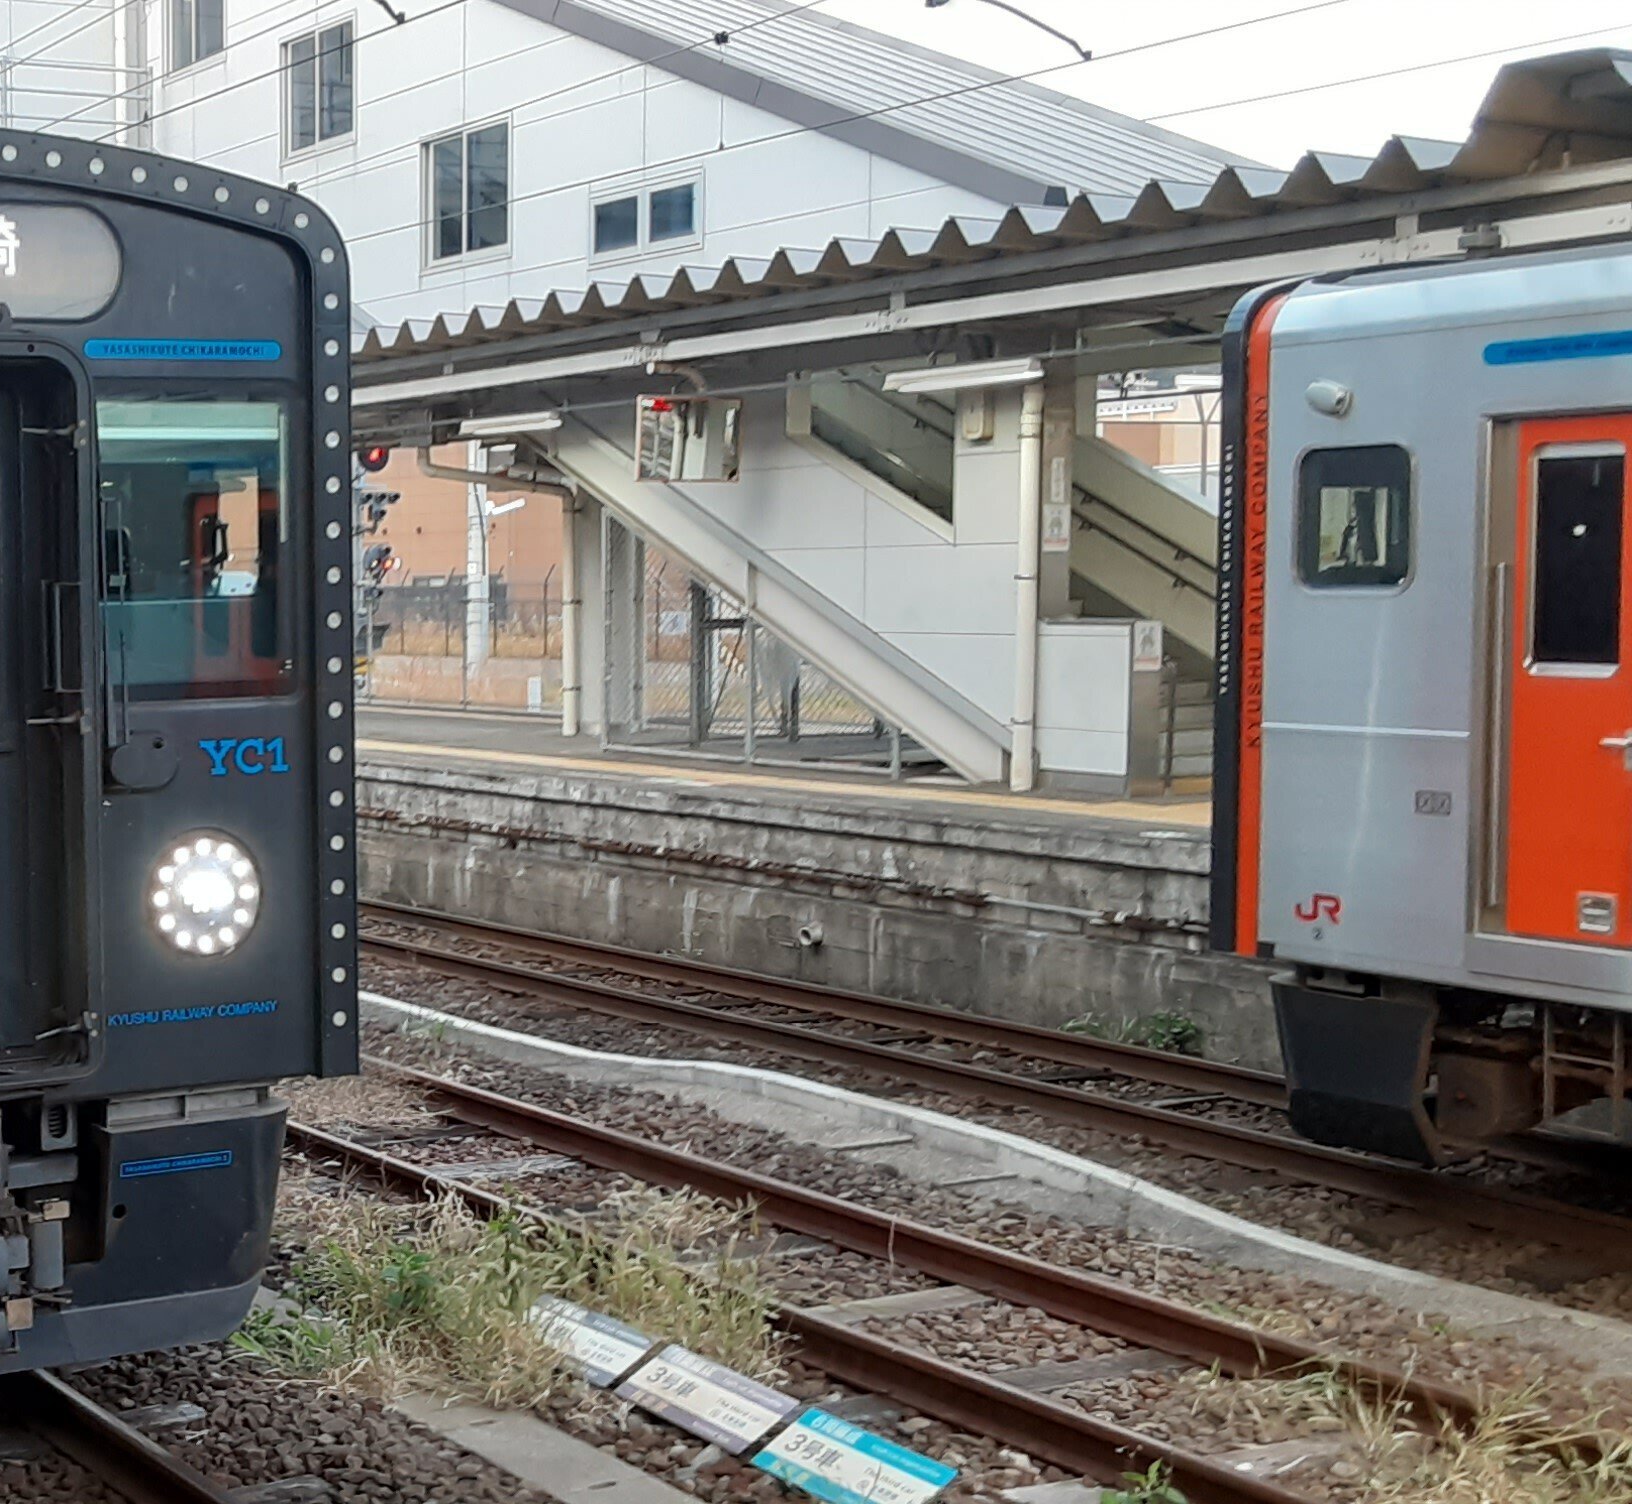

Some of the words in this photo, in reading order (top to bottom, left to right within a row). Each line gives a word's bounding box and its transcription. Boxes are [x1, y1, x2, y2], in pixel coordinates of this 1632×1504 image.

[103, 343, 177, 355] YASASHIKUTE
[181, 345, 265, 356] CHIKARAMOCHI
[1248, 529, 1268, 635] RAILWAY
[1247, 646, 1265, 748] KYUSHU
[197, 736, 290, 775] YC1
[1294, 893, 1343, 925] JR
[107, 1011, 159, 1027] KYUSHU
[162, 1005, 214, 1022] RAILWAY
[217, 1000, 279, 1017] COMPANY
[784, 1433, 845, 1469] 3号車
